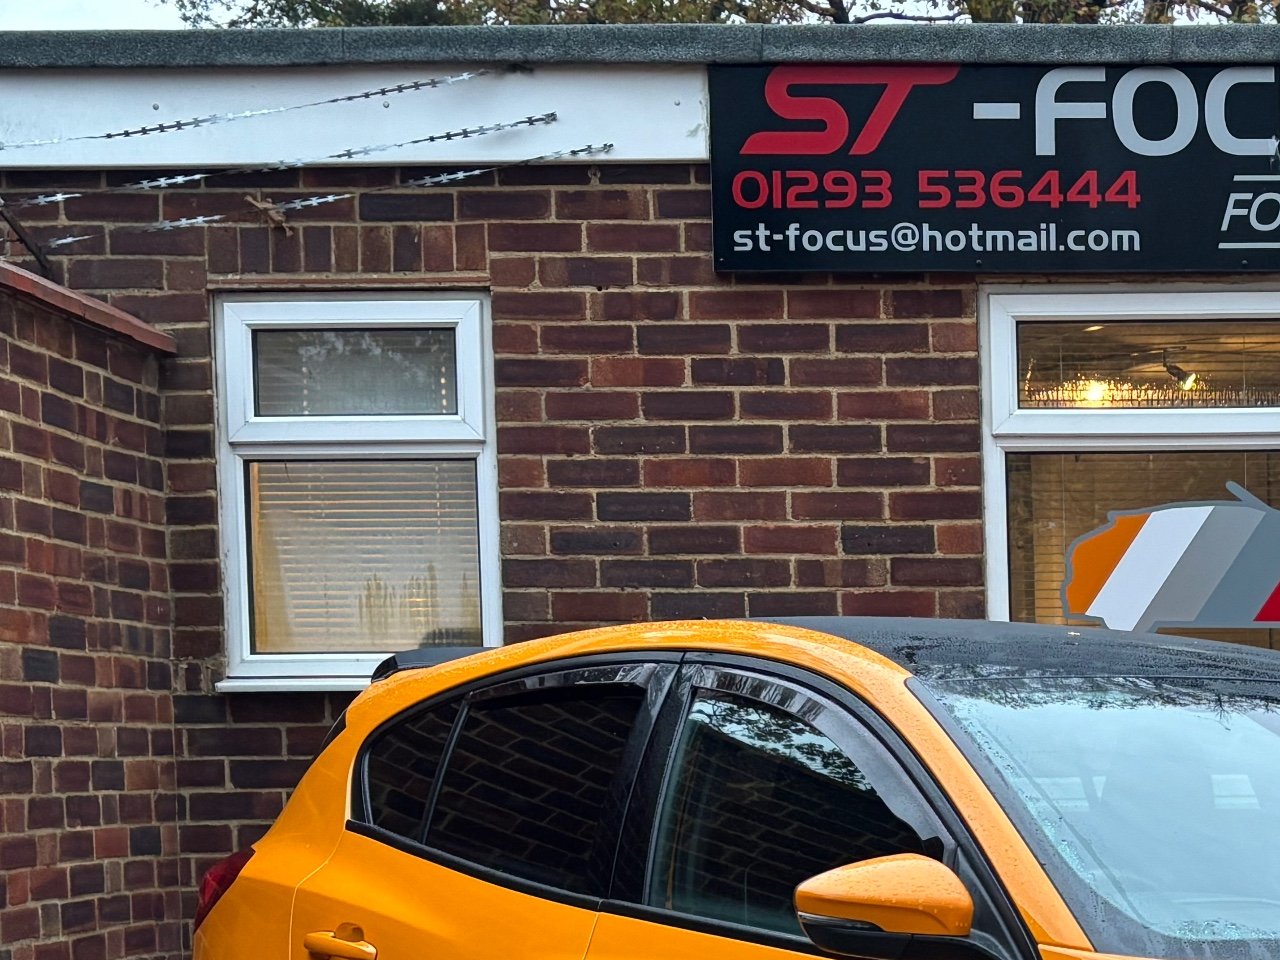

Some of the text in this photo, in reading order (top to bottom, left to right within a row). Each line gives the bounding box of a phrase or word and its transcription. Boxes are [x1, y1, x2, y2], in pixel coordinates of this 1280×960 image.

[731, 169, 1142, 209] 01293 536444
[733, 222, 1142, 252] st-focus@hotmail.com
